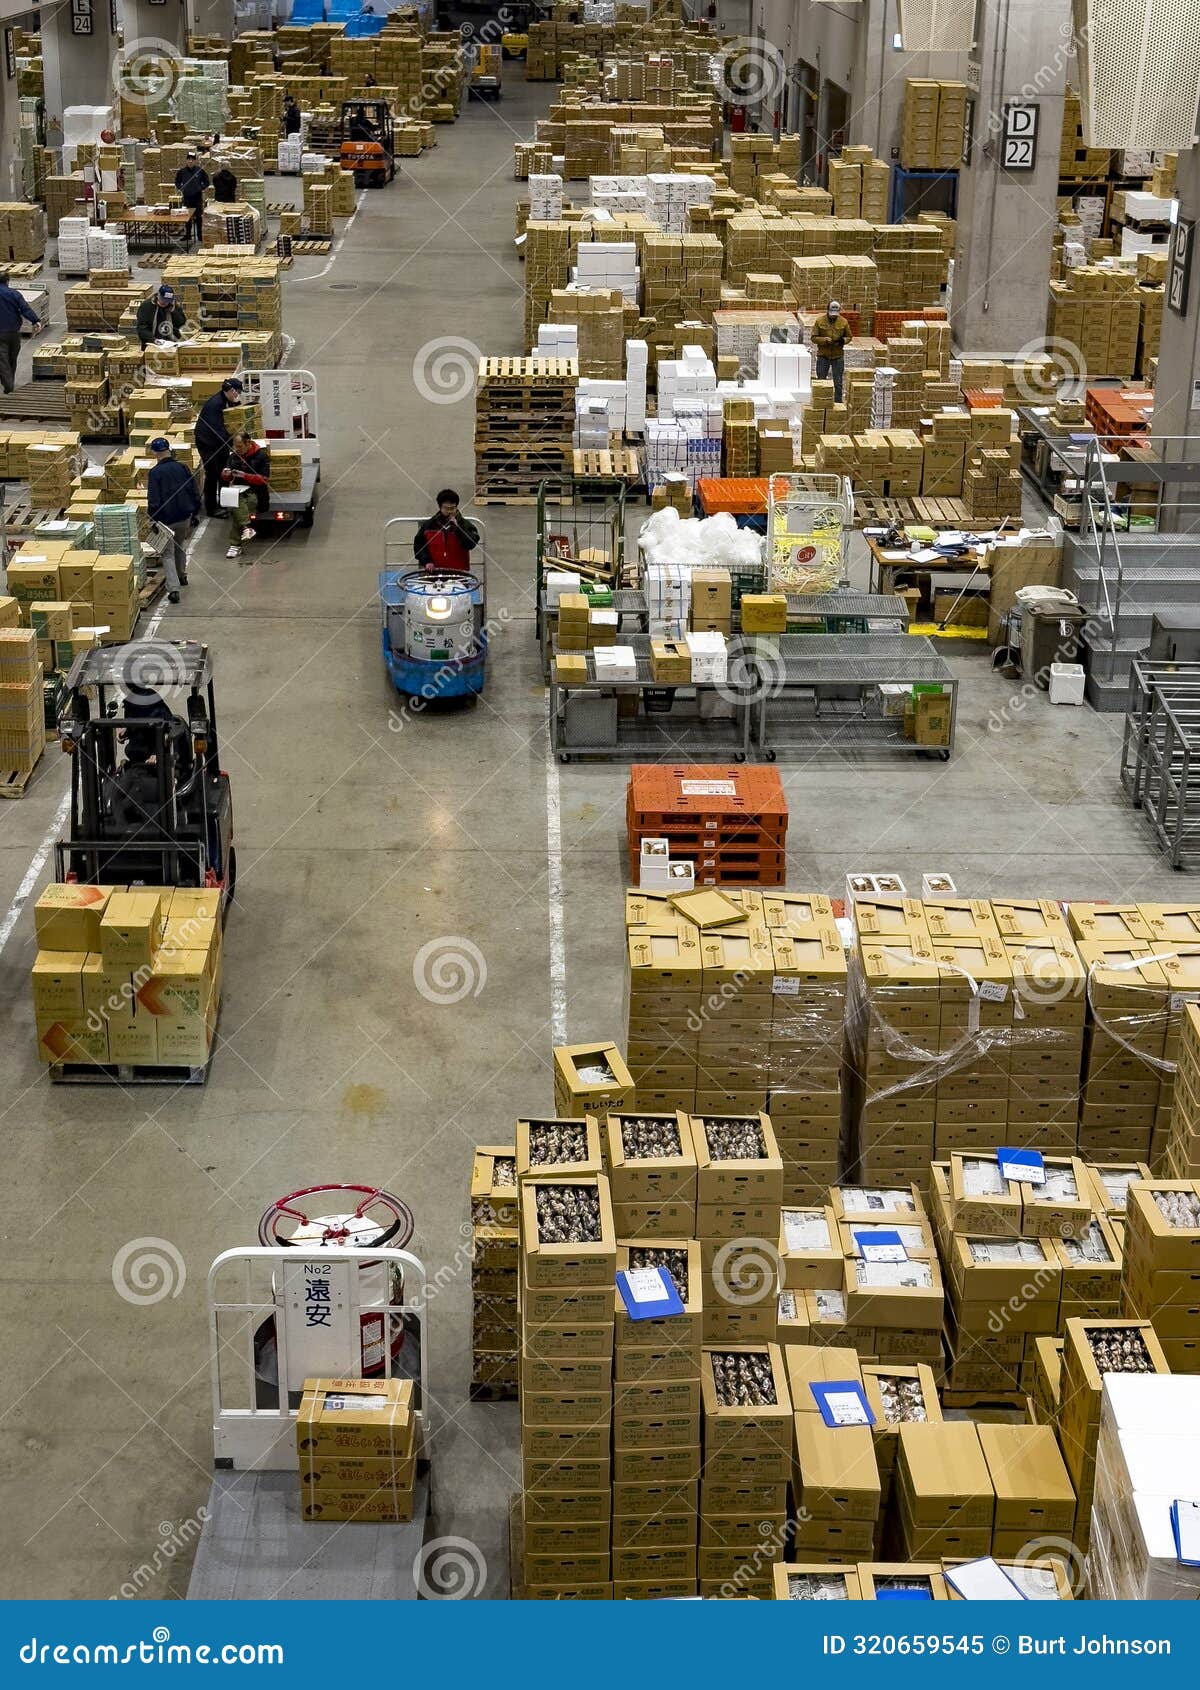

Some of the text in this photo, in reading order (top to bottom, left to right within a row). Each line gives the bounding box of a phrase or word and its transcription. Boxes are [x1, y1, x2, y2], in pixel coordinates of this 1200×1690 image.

[75, 17, 90, 31] 24
[1013, 111, 1031, 132] D
[1007, 141, 1031, 163] 22
[1177, 226, 1186, 257] D
[1172, 269, 1183, 304] 21
[583, 1099, 624, 1110] 生しいたけ
[304, 1264, 332, 1275] No2
[304, 1279, 332, 1327] 遠安
